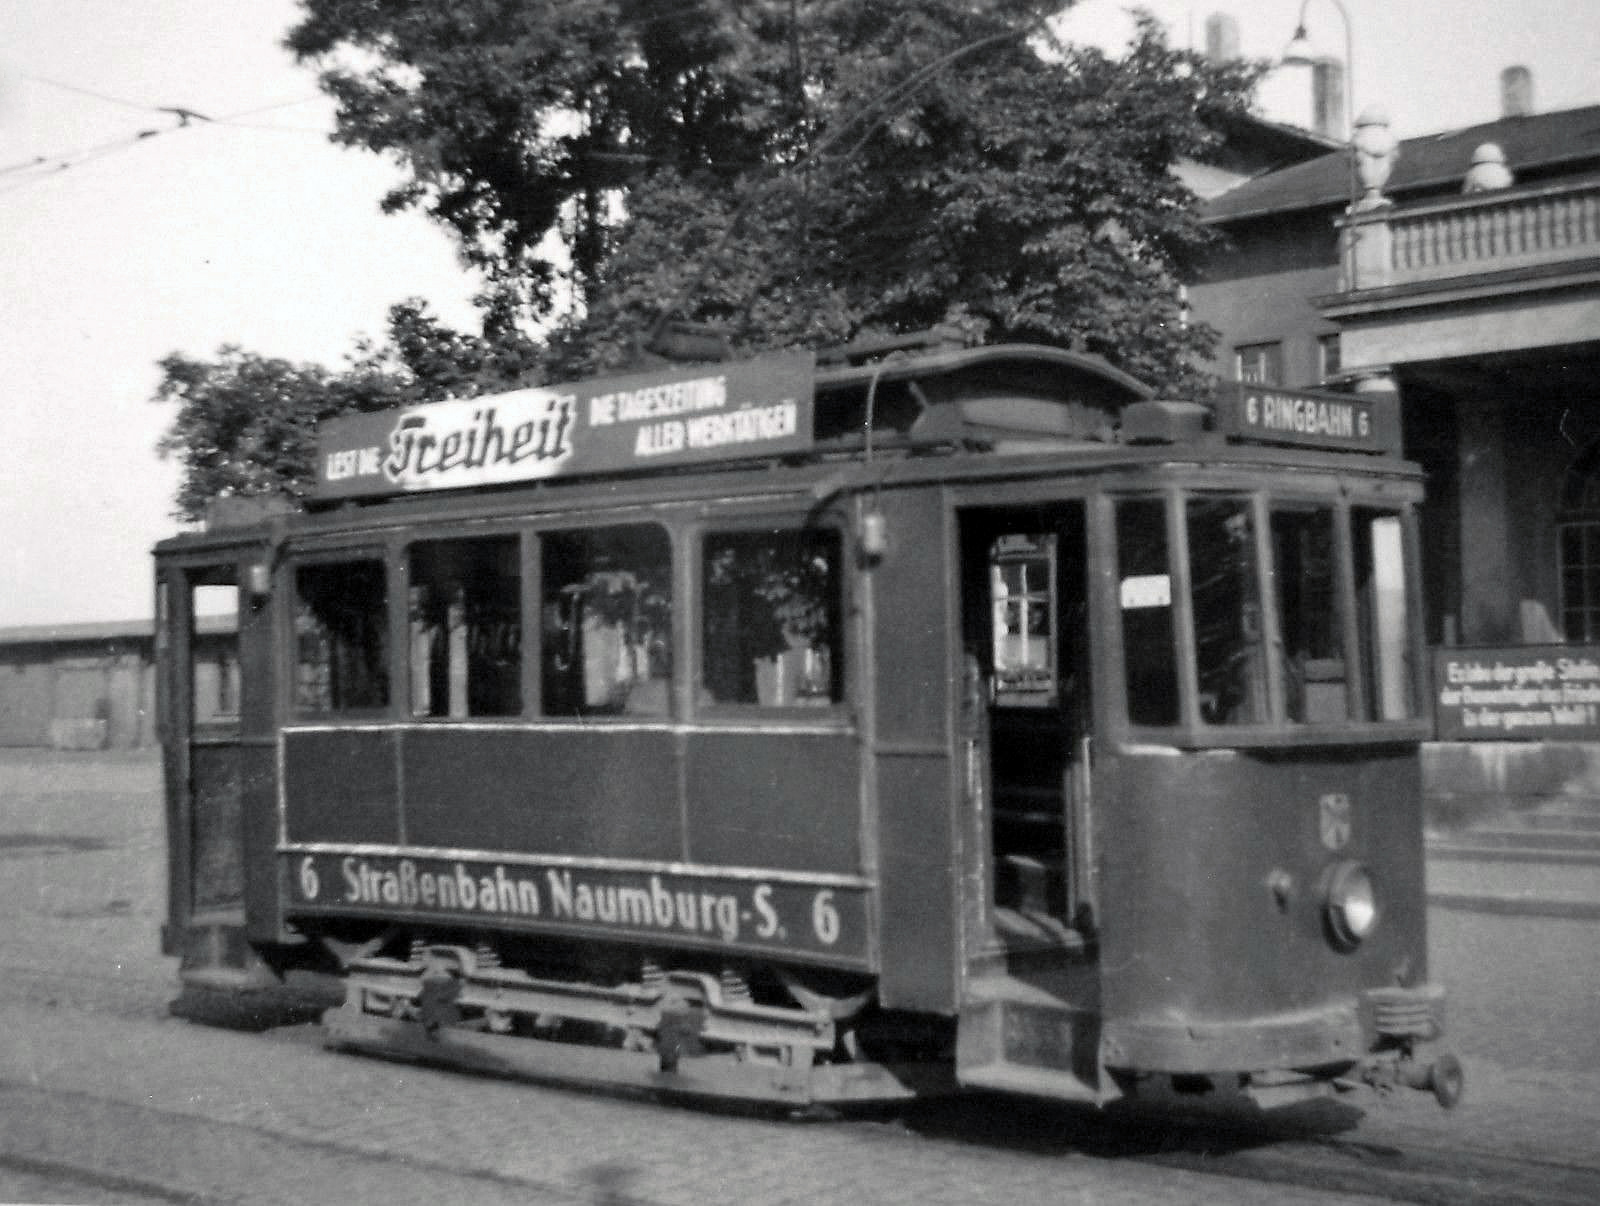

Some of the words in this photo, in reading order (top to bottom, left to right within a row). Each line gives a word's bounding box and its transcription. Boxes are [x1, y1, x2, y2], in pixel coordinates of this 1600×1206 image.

[590, 394, 617, 426] DIE
[618, 376, 727, 421] TAGESZEITUNG
[634, 421, 685, 457] ALLER
[687, 399, 797, 448] WERKTÄTIGEN
[1247, 397, 1259, 425] 6
[1264, 395, 1353, 437] RINGBAHN
[1359, 411, 1369, 437] 6
[386, 398, 573, 478] Freiheit
[301, 856, 319, 900] 6
[344, 858, 540, 916] Straßenbahn
[812, 889, 840, 944] 6
